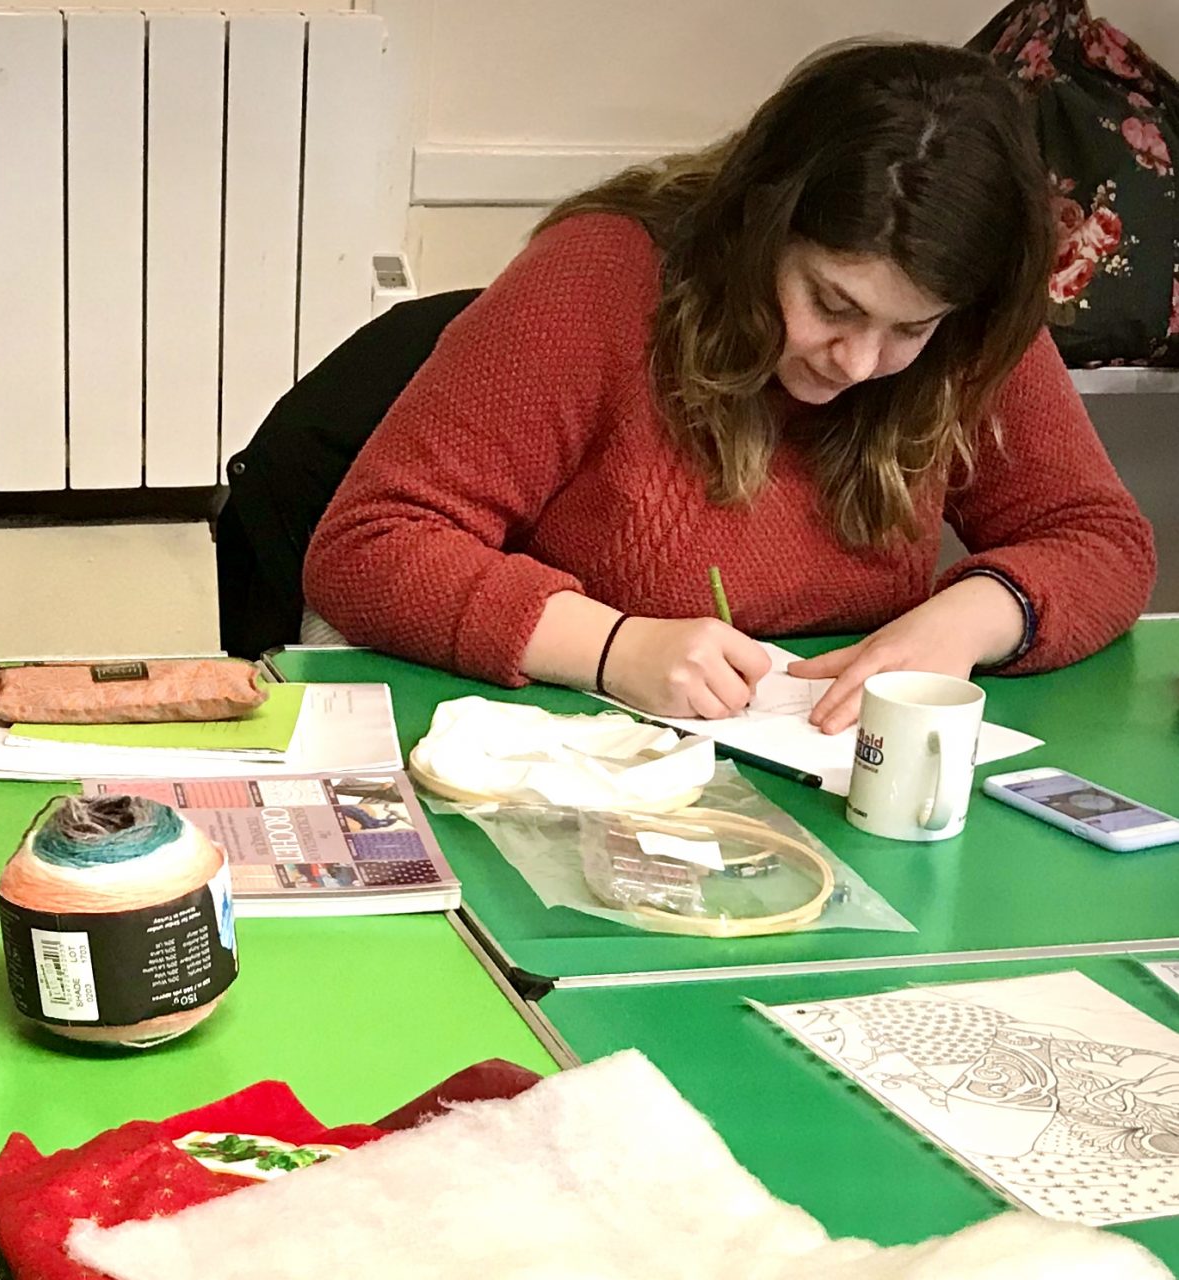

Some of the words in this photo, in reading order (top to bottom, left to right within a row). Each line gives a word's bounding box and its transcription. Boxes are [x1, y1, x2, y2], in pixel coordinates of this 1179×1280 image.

[261, 807, 305, 863] CROCHET
[68, 946, 77, 963] LOT
[72, 978, 83, 1007] SHADE
[180, 993, 198, 1005] 150
